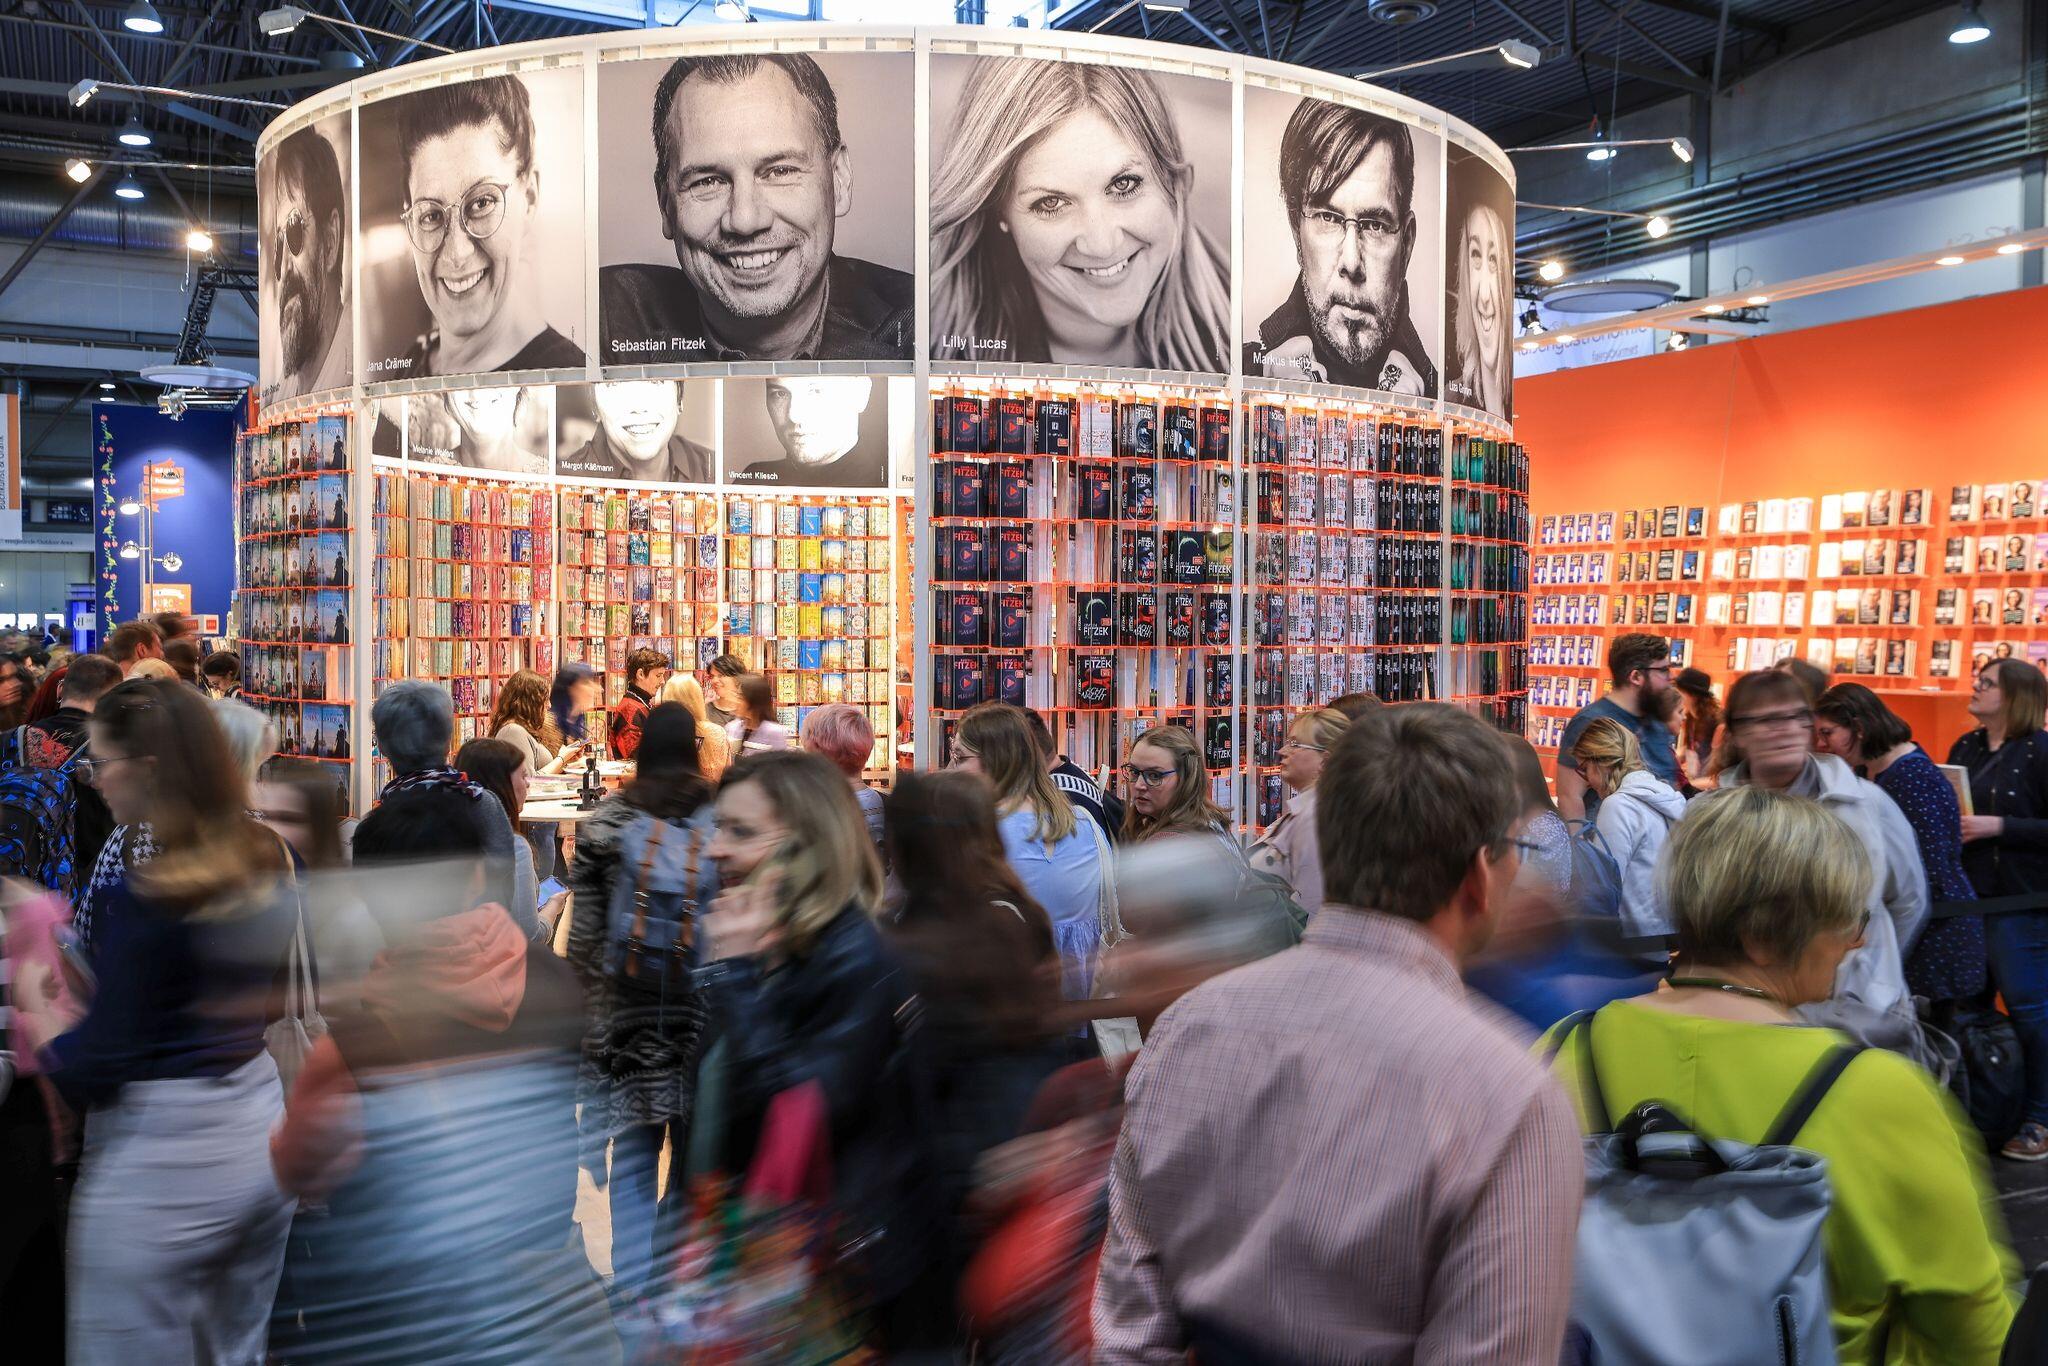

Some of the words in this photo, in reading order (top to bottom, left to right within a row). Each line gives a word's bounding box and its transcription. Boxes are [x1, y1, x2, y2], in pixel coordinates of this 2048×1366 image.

[611, 338, 666, 352] Sebastian
[671, 337, 706, 350] Fitzek
[942, 335, 967, 351] Lilly
[972, 336, 1007, 349] Lucas
[366, 361, 383, 373] Jana
[385, 358, 412, 369] Crämer
[1253, 352, 1286, 367] Markus
[561, 461, 583, 471] Margot
[728, 471, 752, 479] Vincent
[1175, 564, 1201, 575] FITZEK
[1208, 564, 1232, 574] FITZEK
